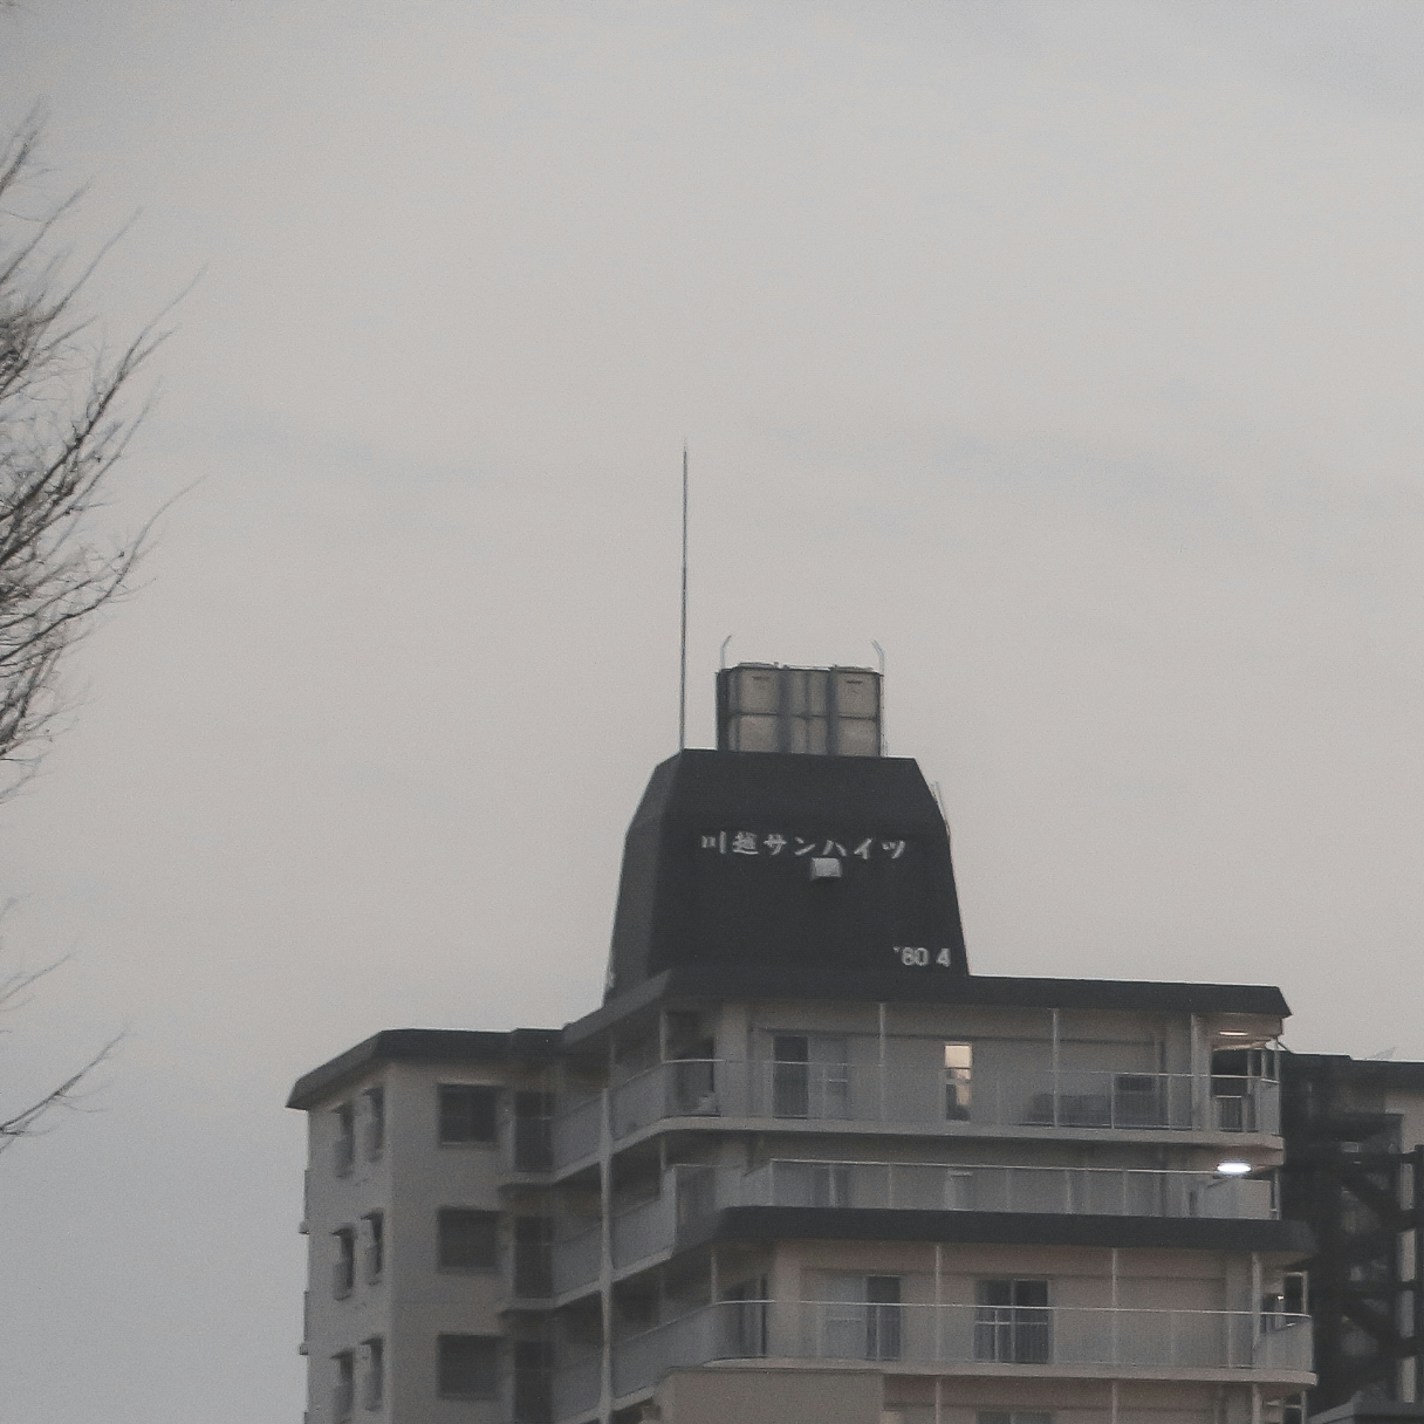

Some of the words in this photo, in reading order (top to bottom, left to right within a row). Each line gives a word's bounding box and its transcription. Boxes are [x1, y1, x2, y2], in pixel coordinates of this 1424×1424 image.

[701, 831, 907, 860] 川越サンハイツ
